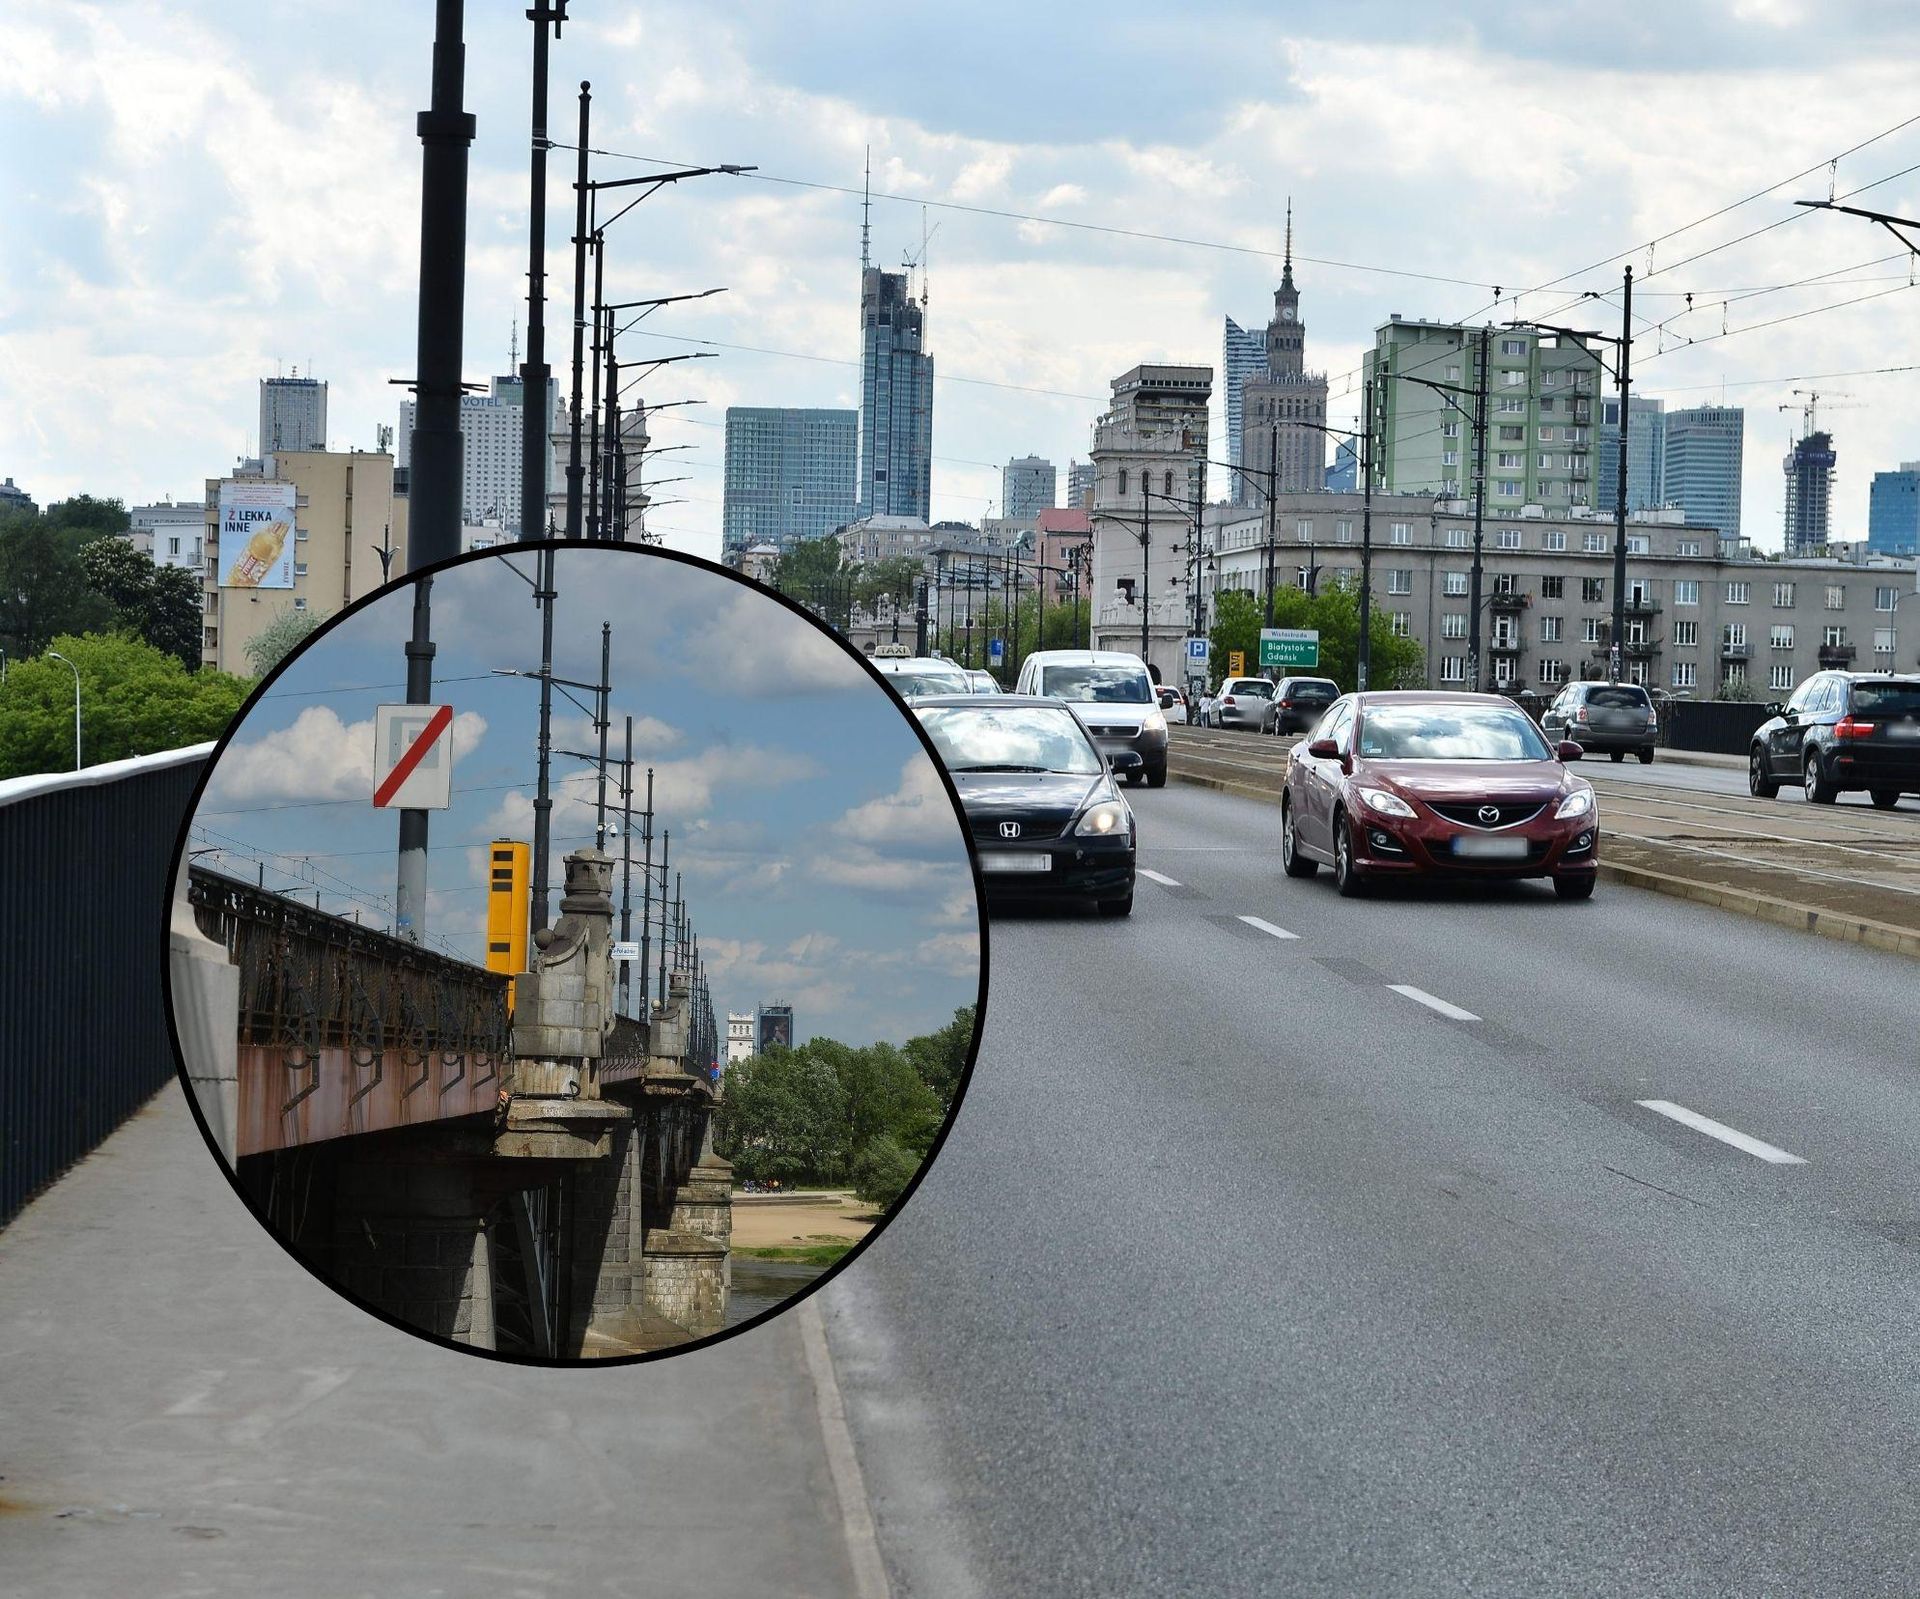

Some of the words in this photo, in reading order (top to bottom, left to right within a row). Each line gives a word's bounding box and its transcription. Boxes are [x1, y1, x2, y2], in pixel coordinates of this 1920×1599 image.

[462, 397, 502, 407] VOTEL
[239, 511, 272, 521] LEKKA
[225, 521, 250, 532] INNE
[1193, 642, 1204, 656] P
[1267, 642, 1305, 653] Białystok
[1266, 652, 1298, 661] Gdańsk
